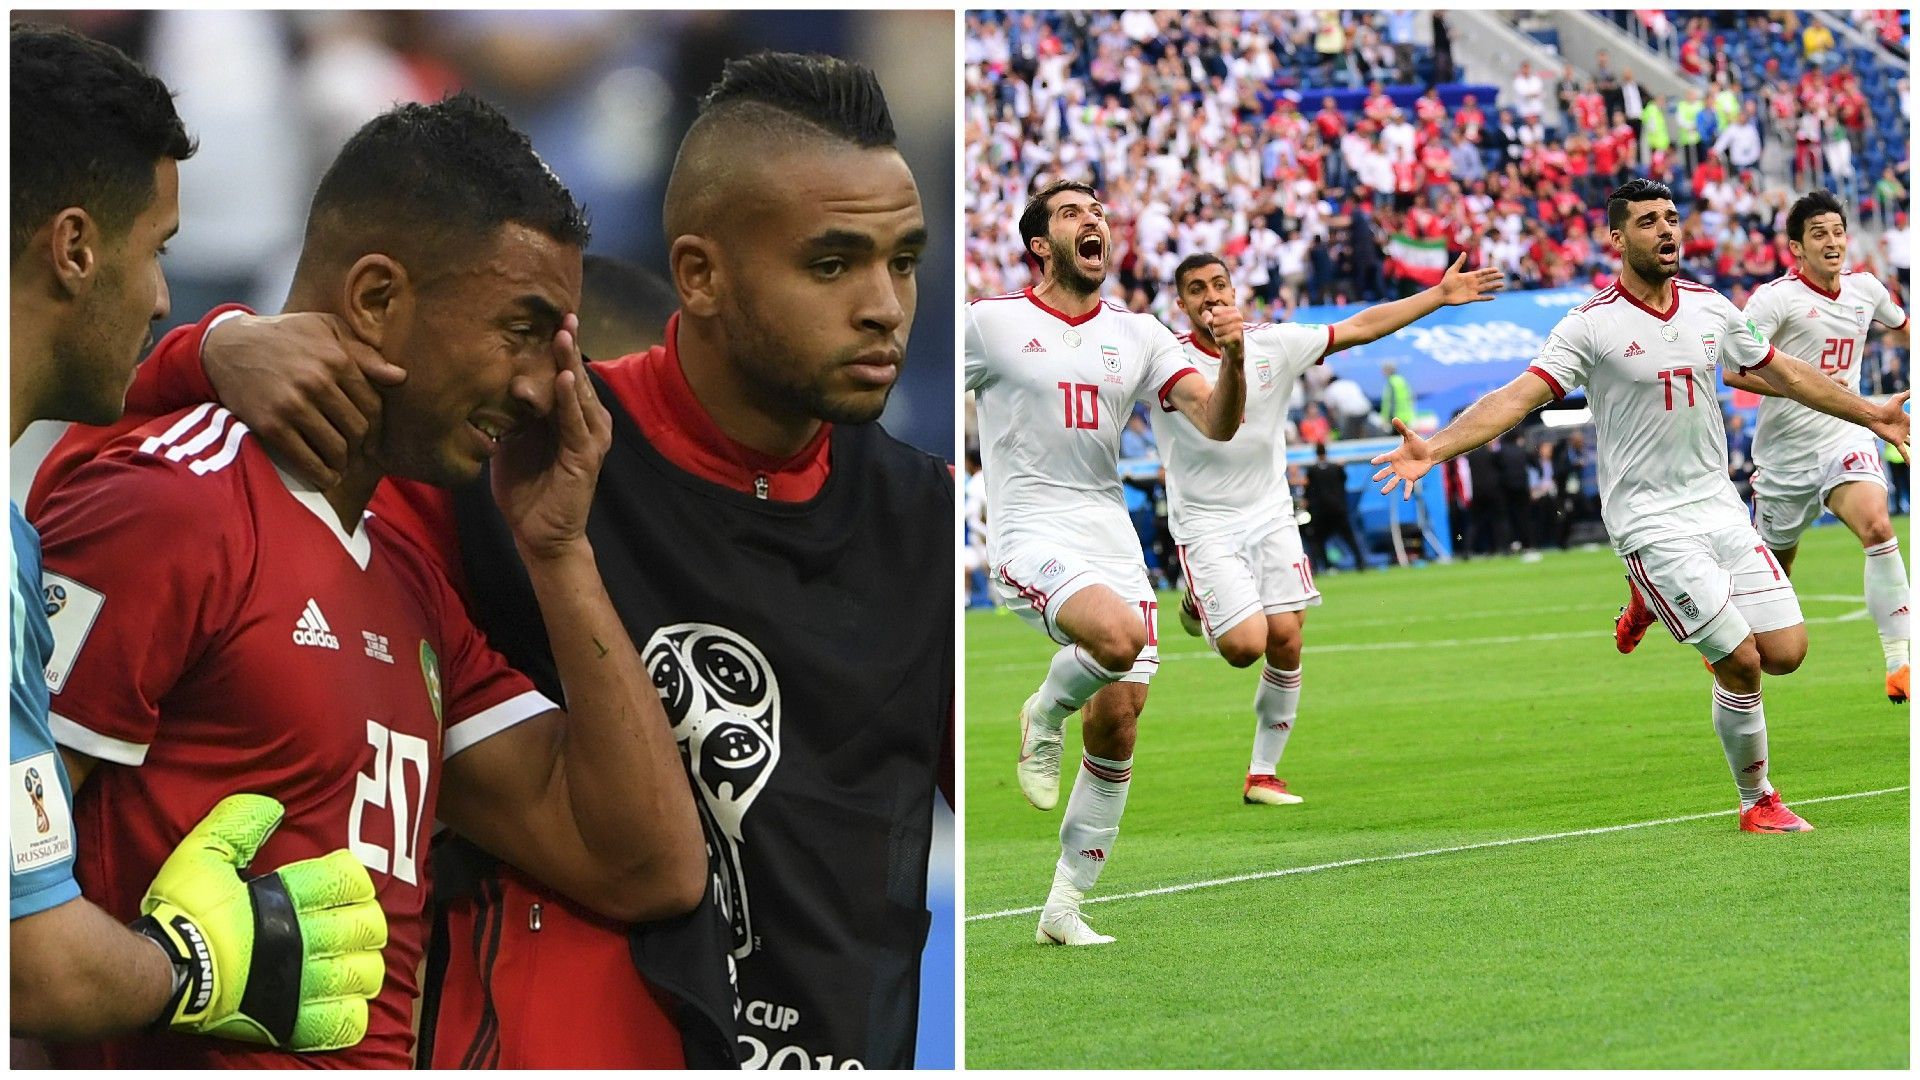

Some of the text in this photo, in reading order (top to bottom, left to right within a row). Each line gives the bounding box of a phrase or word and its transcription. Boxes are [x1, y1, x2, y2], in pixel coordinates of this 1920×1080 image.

[1820, 338, 1855, 370] 20
[1057, 381, 1099, 430] 10
[292, 627, 340, 650] adidas
[348, 719, 430, 888] 20
[16, 845, 52, 864] RUSSIA
[180, 923, 213, 1008] MUNIR
[745, 1000, 800, 1032] CUP
